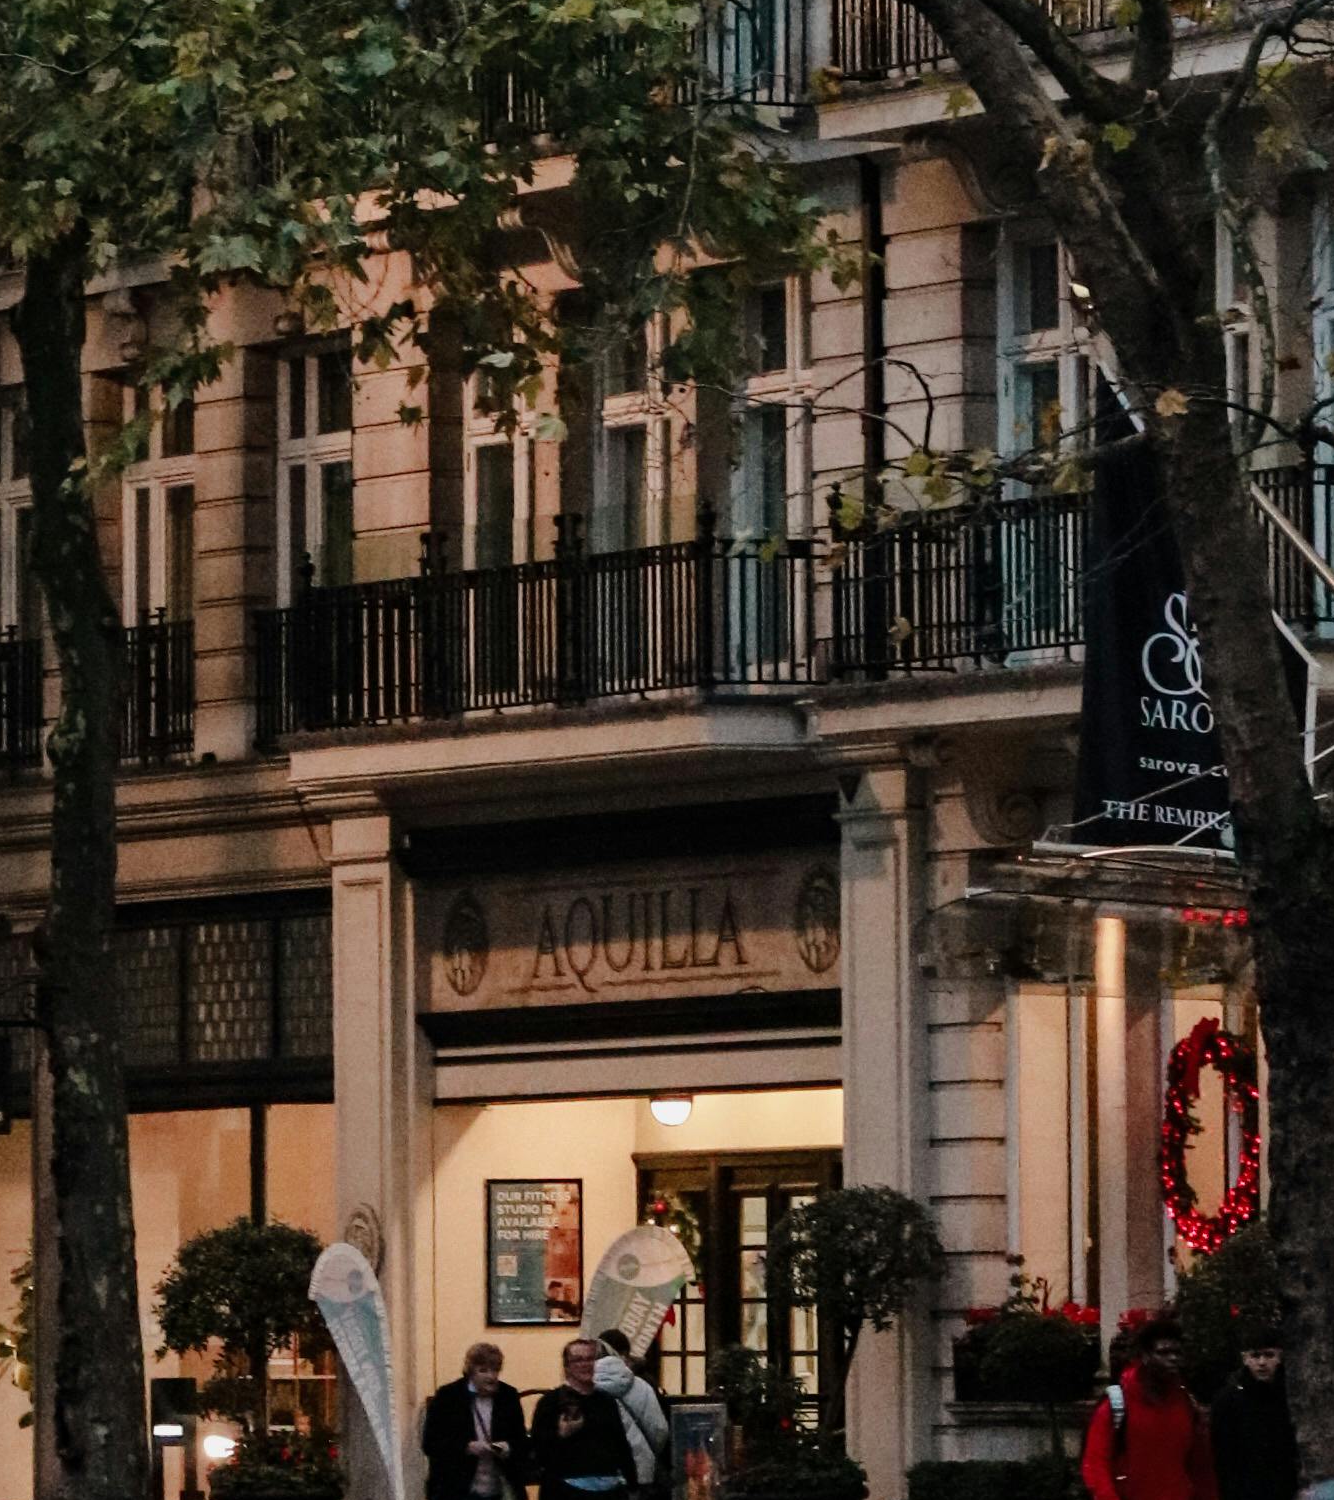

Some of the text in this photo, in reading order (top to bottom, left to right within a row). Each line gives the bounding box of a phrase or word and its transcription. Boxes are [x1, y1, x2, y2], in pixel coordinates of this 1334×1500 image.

[532, 887, 748, 993] AQUILLA
[496, 1191, 523, 1201] OUR
[496, 1203, 554, 1215] STUDIO IS
[497, 1217, 559, 1228] AVAILABLE
[497, 1229, 550, 1240] FOR HIRE
